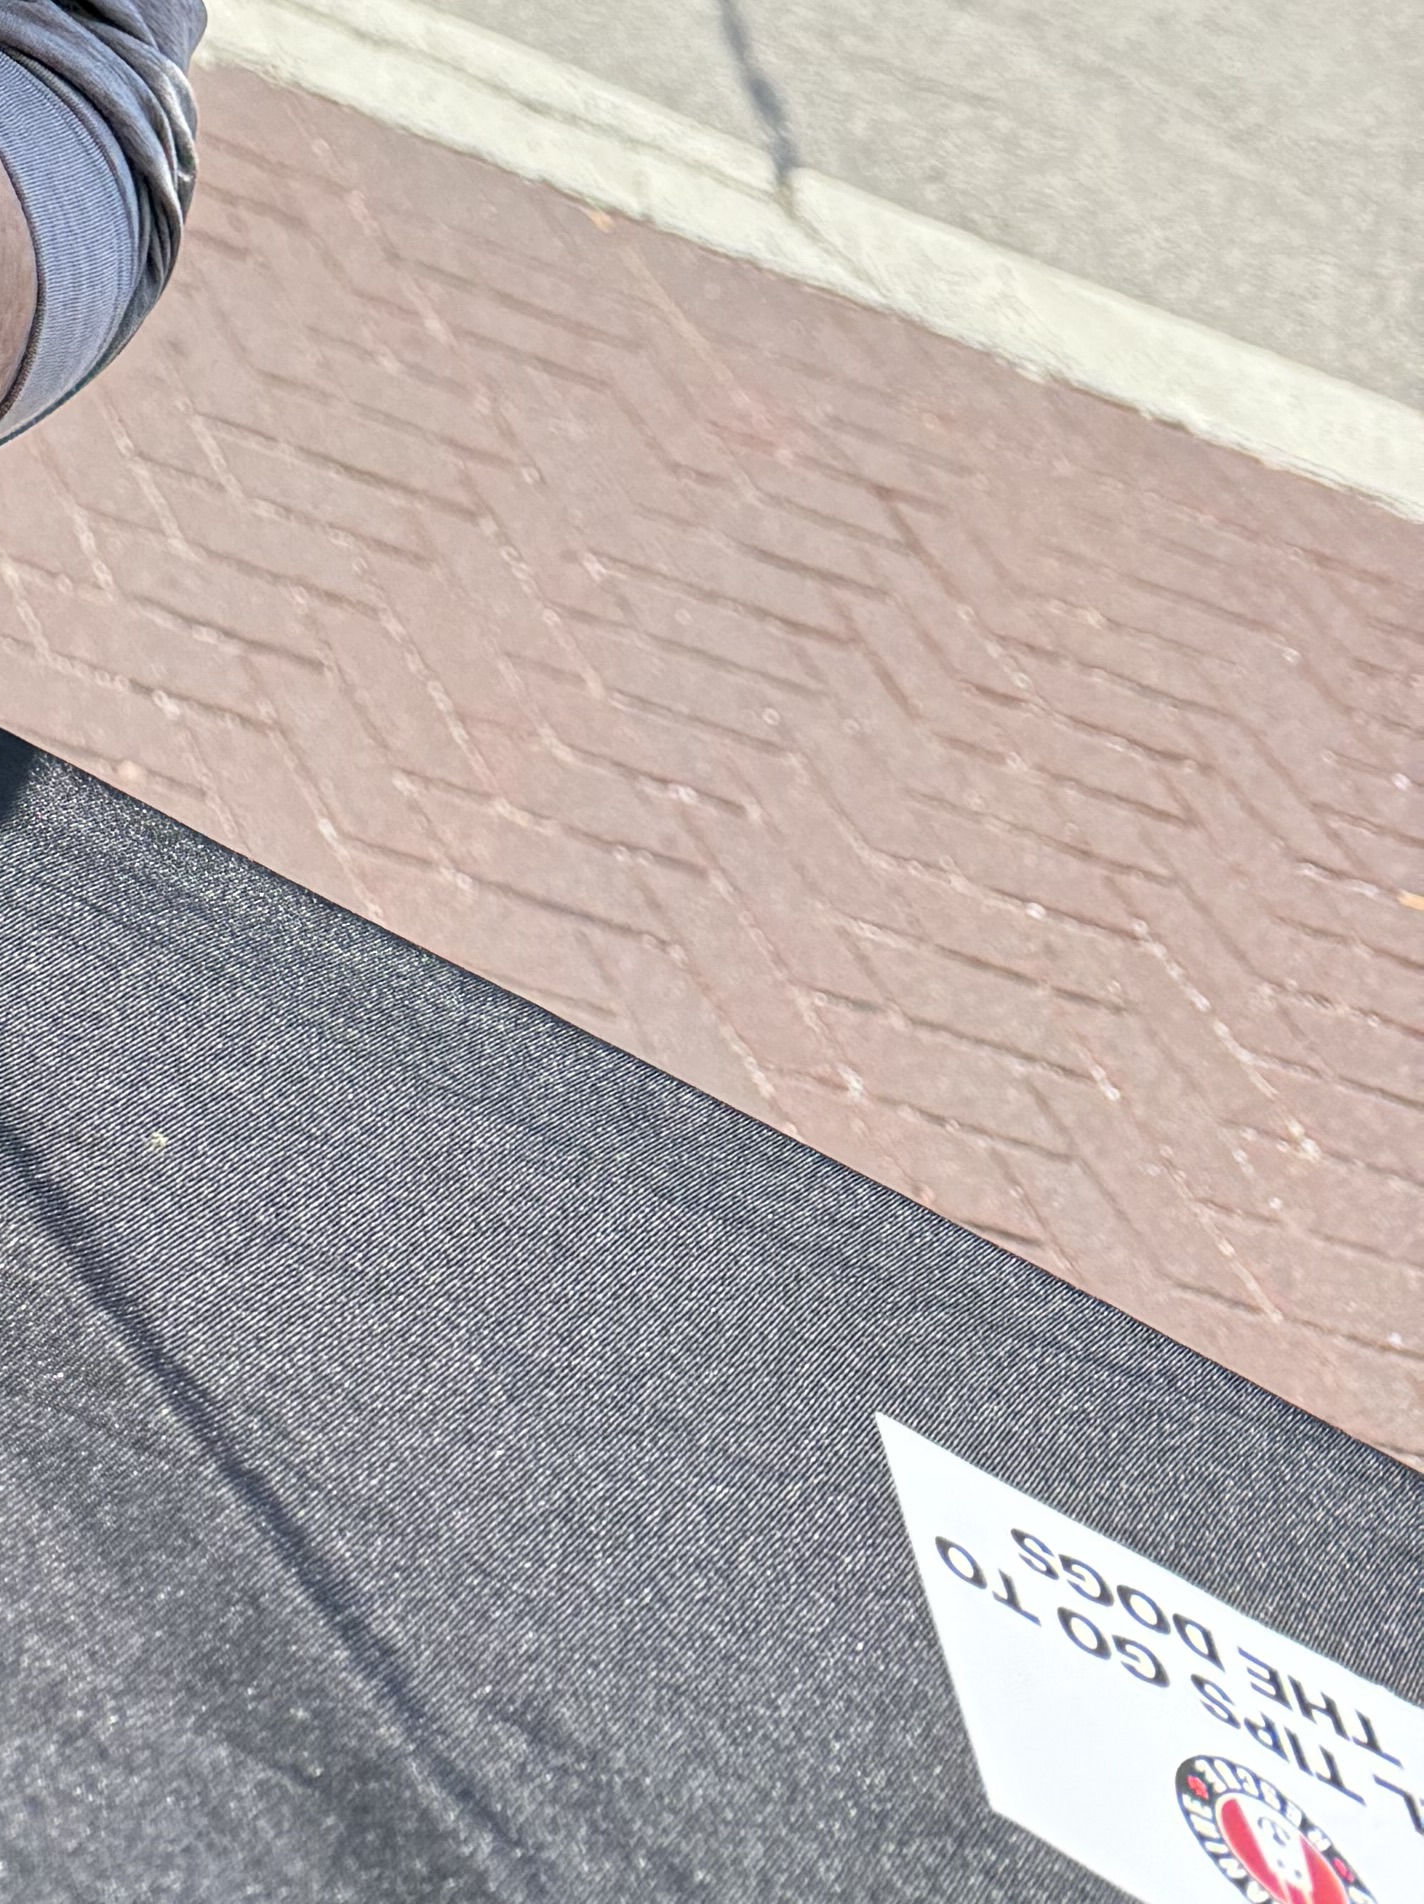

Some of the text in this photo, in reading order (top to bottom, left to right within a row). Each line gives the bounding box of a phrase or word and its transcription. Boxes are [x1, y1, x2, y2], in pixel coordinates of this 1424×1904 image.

[935, 1536, 1043, 1628] TO
[1010, 1528, 1403, 1768] THE DOGS
[1057, 1606, 1171, 1688] GO
[1190, 1674, 1368, 1808] TIPS
